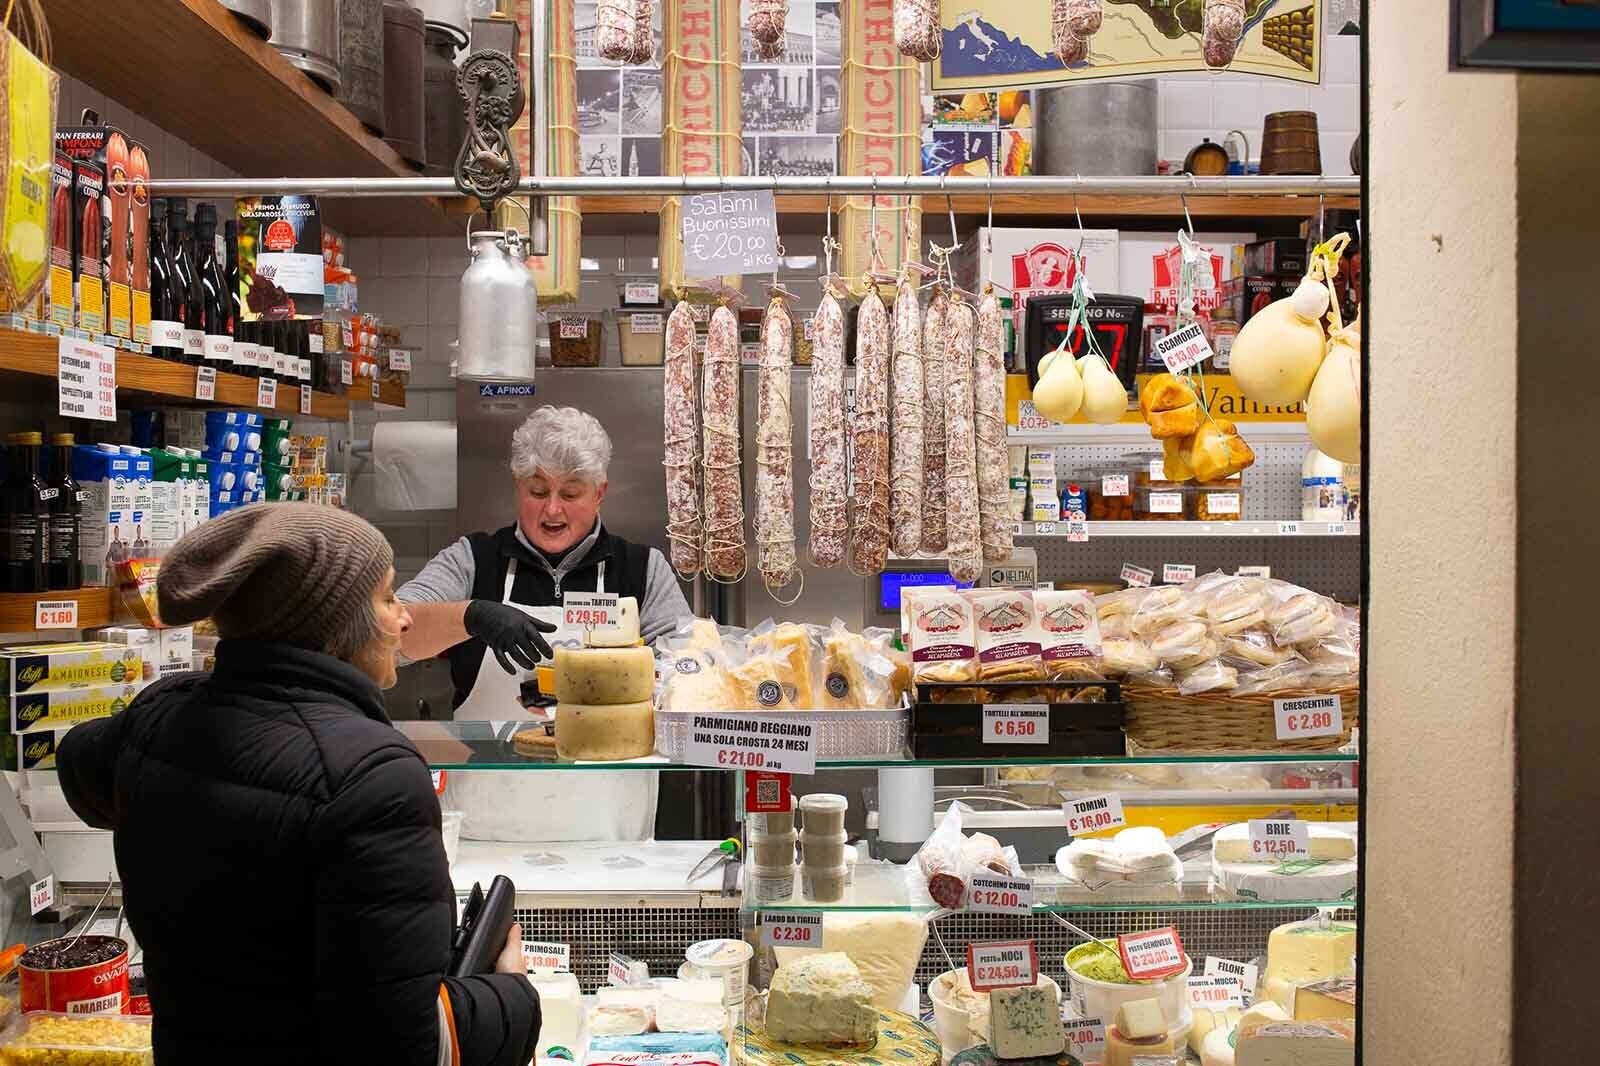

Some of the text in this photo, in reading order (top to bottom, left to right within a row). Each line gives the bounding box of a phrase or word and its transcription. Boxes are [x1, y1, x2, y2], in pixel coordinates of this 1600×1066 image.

[682, 0, 713, 174] URICCH
[73, 132, 104, 140] FERRARI
[690, 193, 758, 215] Salami
[683, 217, 770, 234] Buonissimi
[690, 233, 709, 261] €
[756, 254, 774, 265] KG
[1051, 308, 1125, 319] SERNG No.
[1158, 325, 1201, 354] SCAMORZE
[1167, 343, 1200, 367] € 13,00
[497, 386, 531, 394] AFINOX
[592, 599, 617, 607] TARTUFO
[41, 611, 72, 624] € 1,60
[566, 609, 574, 624] €
[576, 609, 607, 625] 29,50
[60, 667, 106, 680] MAIONESE
[60, 704, 106, 717] MAIONESE
[1282, 698, 1334, 711] CRESCENTINE
[694, 716, 812, 737] PARMIGIANO REGGIANO
[1288, 712, 1331, 730] € 2,80
[995, 721, 1035, 736] € 6,50
[694, 733, 808, 752] UNA SOLA CROSTA 24 MESI
[718, 750, 726, 764] €
[730, 750, 764, 768] 21,00
[774, 761, 781, 769] kg
[1073, 797, 1107, 814] TOMINI
[1070, 811, 1111, 831] € 16,00
[1266, 823, 1291, 835] BRIE
[1253, 840, 1261, 853] €
[1263, 840, 1295, 853] 12,50
[973, 879, 1030, 891] COTECHINO CRUDO
[974, 890, 982, 904] €
[985, 891, 1018, 907] 12,00
[764, 914, 785, 923] LARDO
[797, 916, 820, 924] TIGELLE
[773, 927, 811, 941] € 2,30
[524, 944, 565, 955] PRIMOSALE
[1001, 950, 1023, 962] NOCI
[978, 965, 1019, 980] € 24,50
[1217, 962, 1245, 976] FILONE
[1214, 977, 1238, 985] MUCCA
[72, 996, 118, 1014] AMARENA
